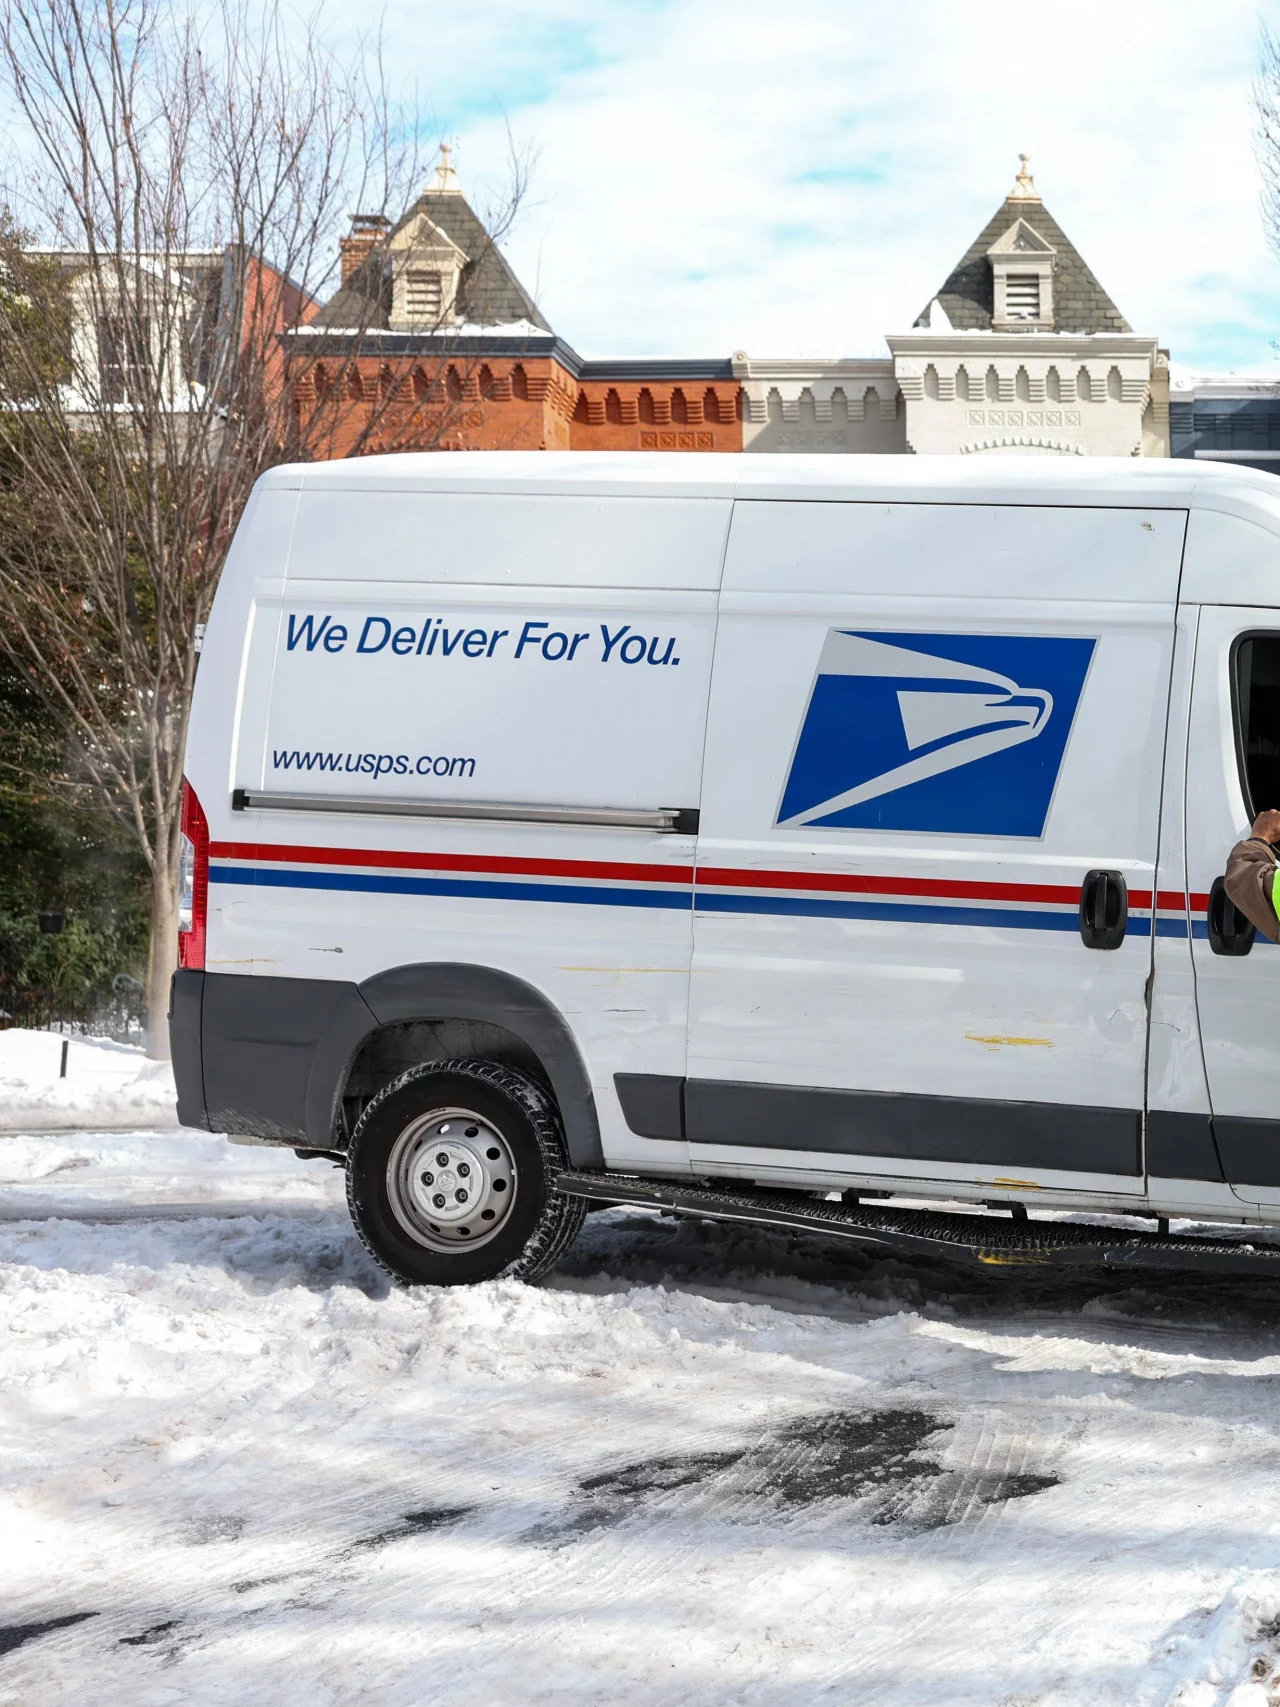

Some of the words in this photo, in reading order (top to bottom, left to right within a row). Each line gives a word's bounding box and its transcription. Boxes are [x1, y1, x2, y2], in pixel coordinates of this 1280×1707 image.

[286, 614, 347, 653] We
[356, 616, 508, 658] Deliver
[514, 621, 589, 661] For
[600, 624, 681, 666] You.
[272, 749, 476, 779] www.usps.com
